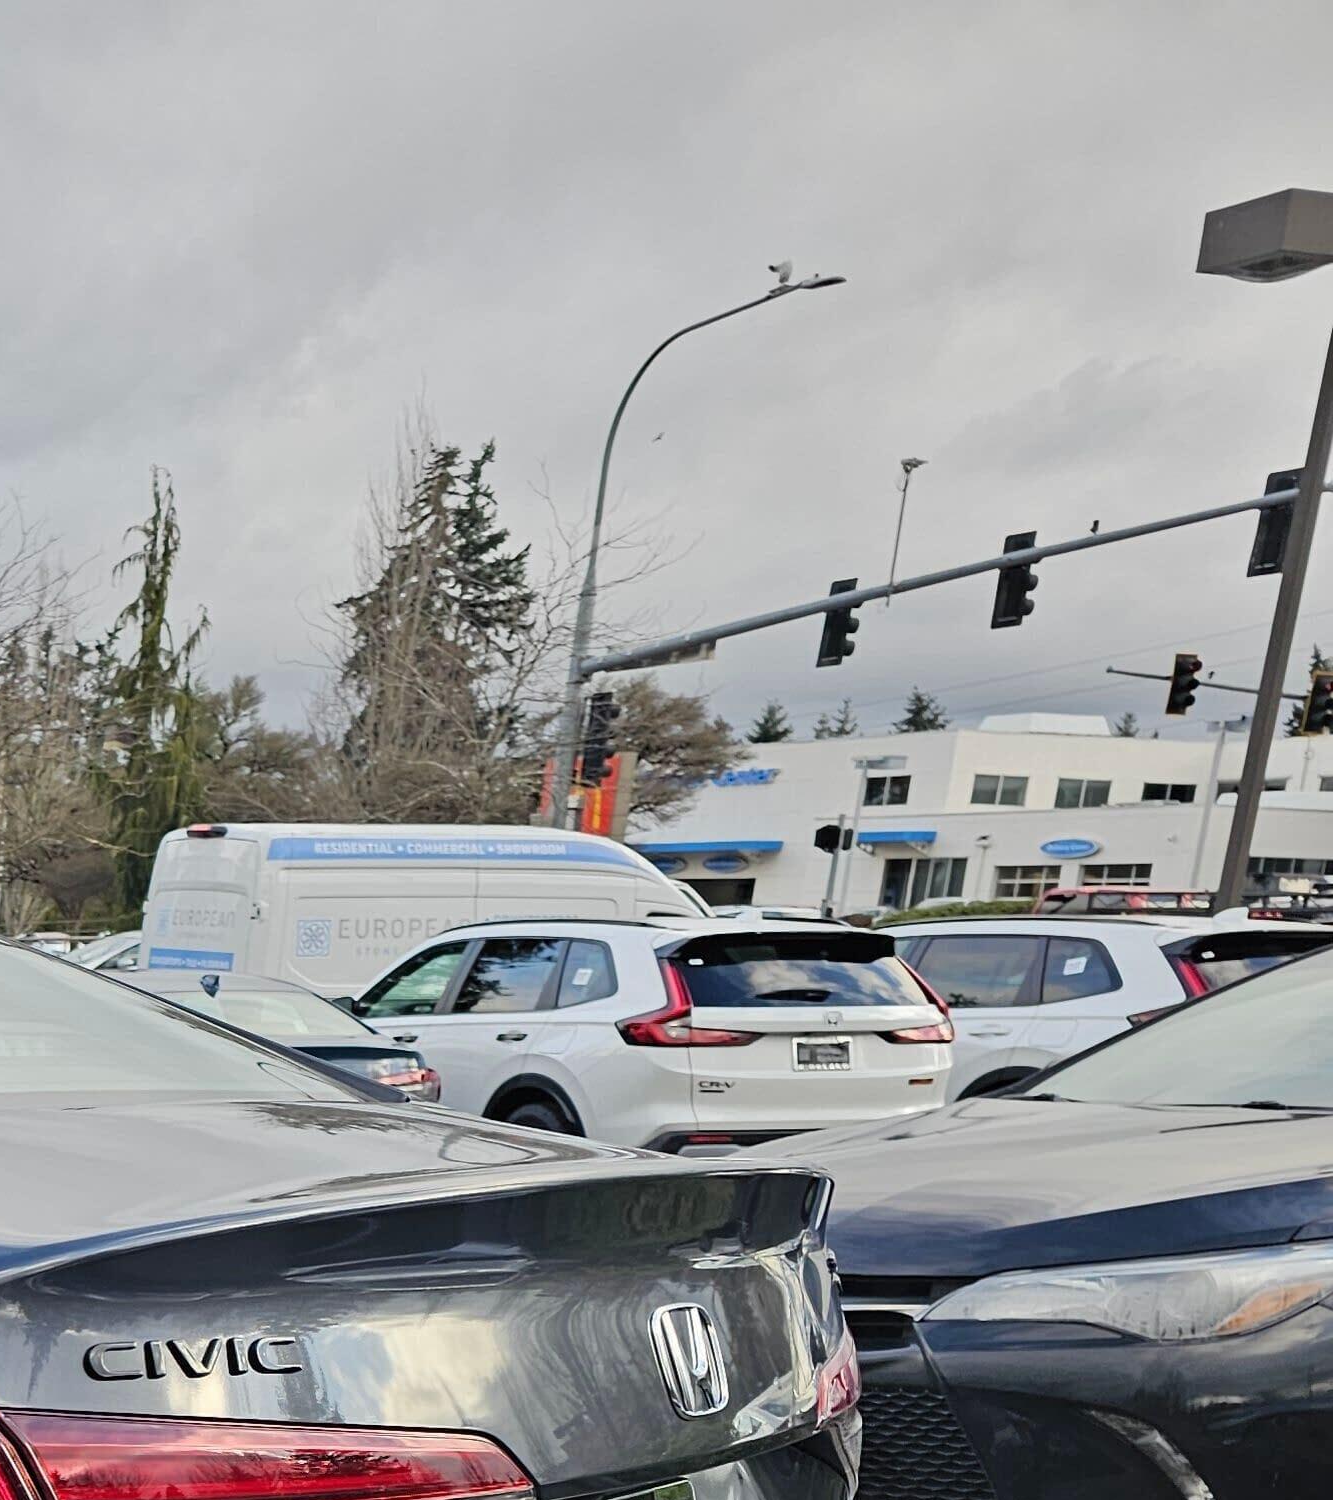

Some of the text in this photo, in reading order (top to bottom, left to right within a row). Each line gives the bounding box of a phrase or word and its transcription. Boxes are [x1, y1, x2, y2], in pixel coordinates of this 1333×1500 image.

[314, 842, 566, 856] RESIDENTIAL COMMERCIAL SHOWROOM
[698, 1080, 735, 1089] CR-V
[83, 1336, 303, 1381] CIVIC
